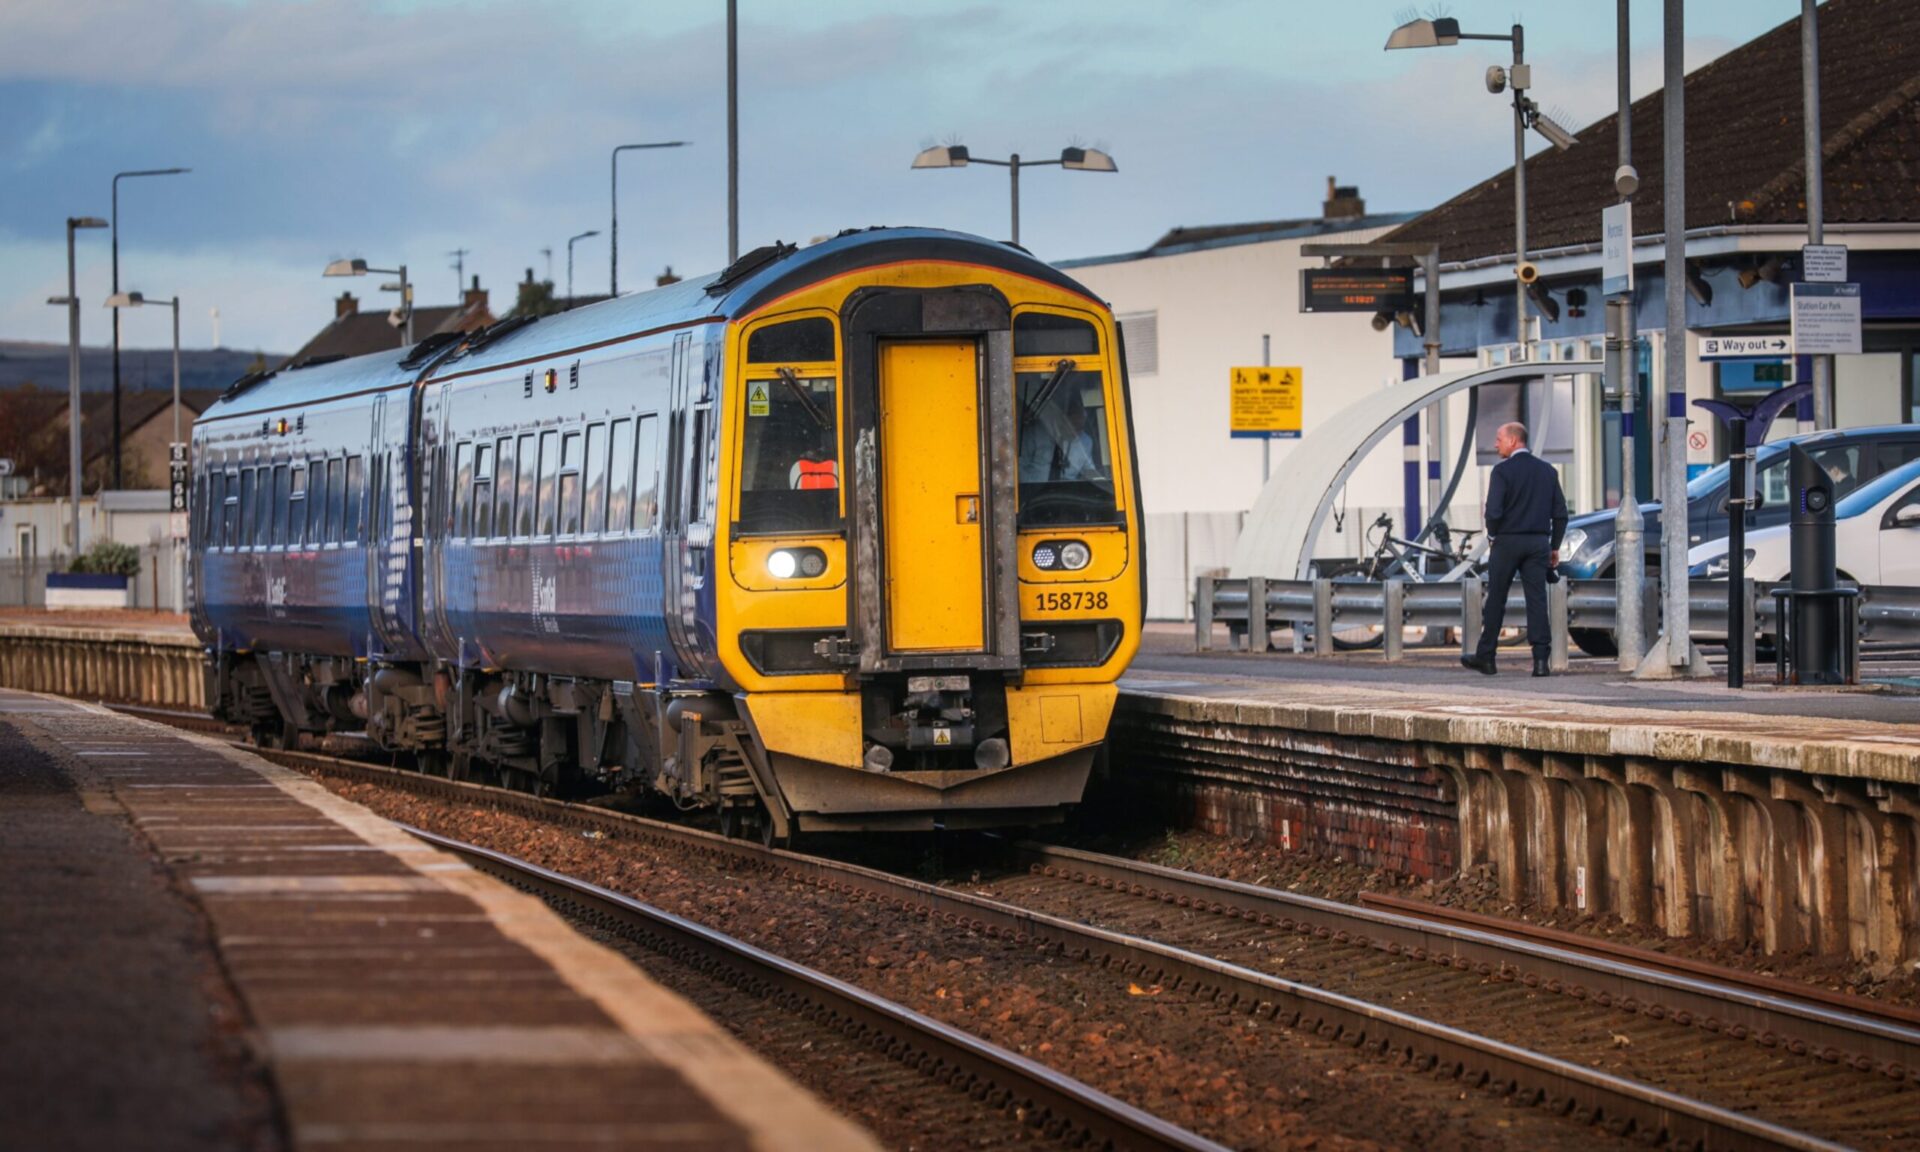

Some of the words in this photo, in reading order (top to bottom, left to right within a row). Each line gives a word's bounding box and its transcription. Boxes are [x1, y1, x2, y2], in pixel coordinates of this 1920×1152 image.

[1797, 302, 1818, 310] Station
[1819, 302, 1828, 310] Car
[1829, 302, 1842, 310] Park
[1722, 340, 1745, 352] Way
[1748, 341, 1767, 350] out
[1036, 591, 1108, 611] 158738
